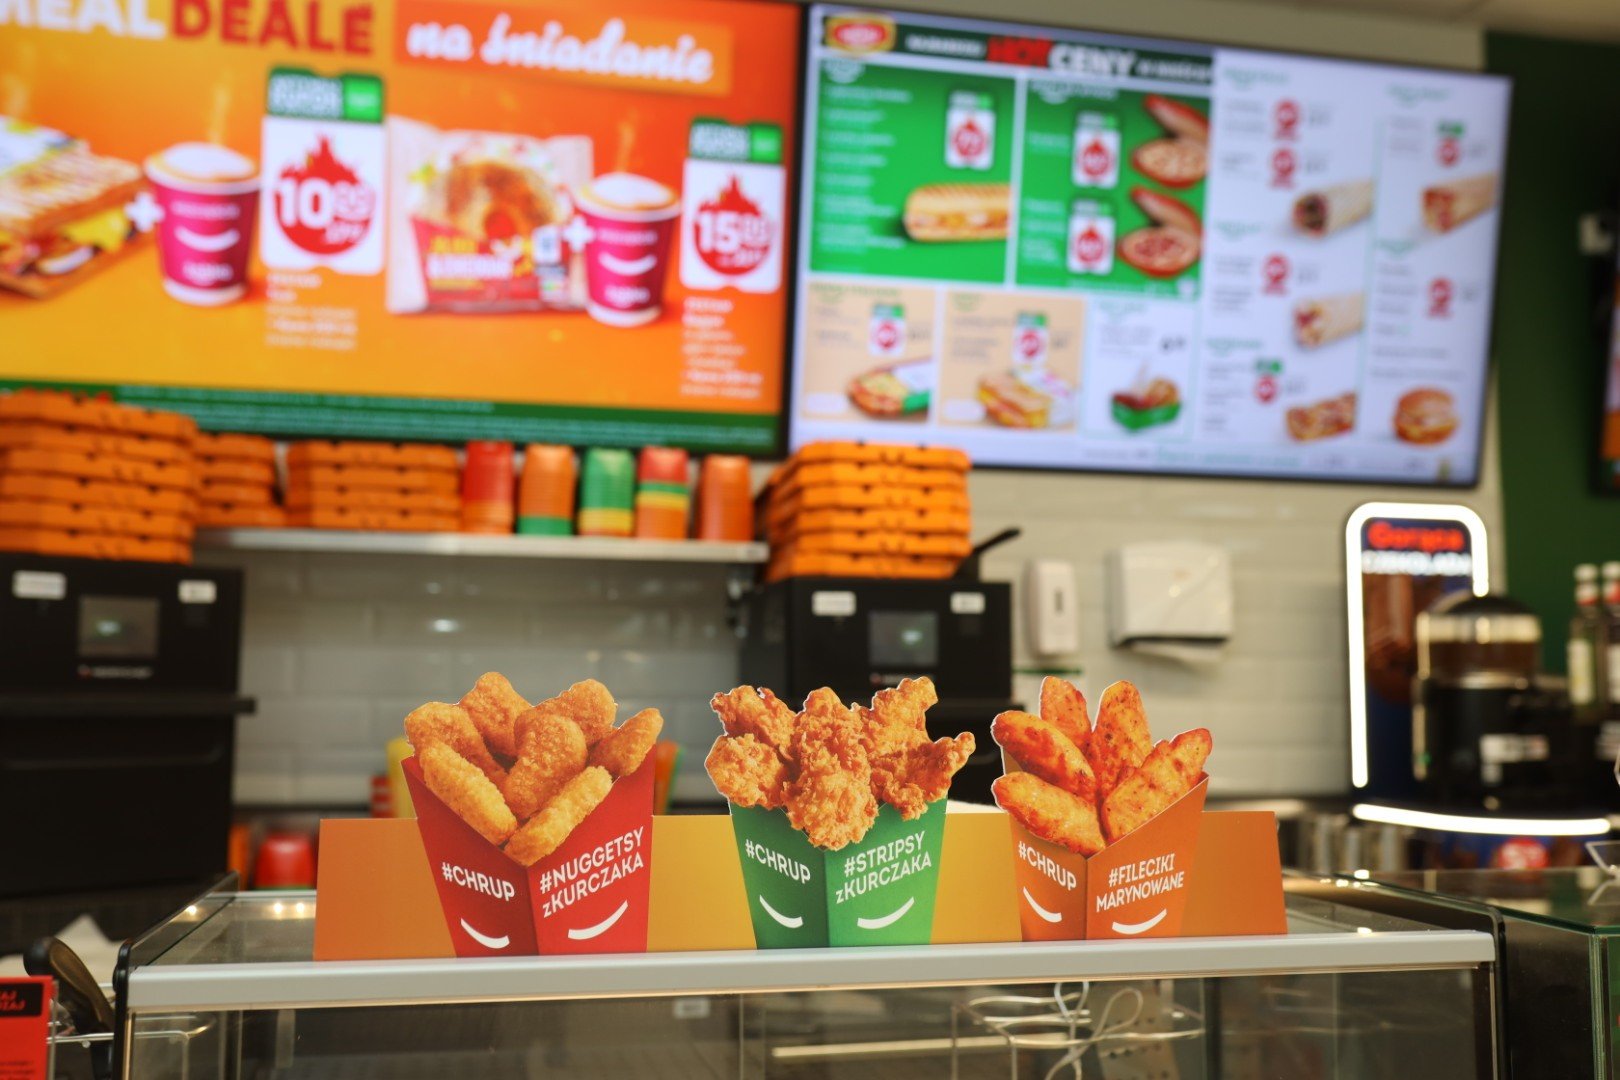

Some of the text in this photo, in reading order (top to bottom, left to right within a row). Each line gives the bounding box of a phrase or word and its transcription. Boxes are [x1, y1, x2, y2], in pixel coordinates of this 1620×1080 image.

[540, 826, 644, 894] #NUGGETSY
[745, 838, 811, 884] #CHRUP
[844, 831, 925, 878] #STRIPSY
[1018, 841, 1077, 891] #CHRUP
[1109, 853, 1175, 887] #FILECIKI
[441, 861, 515, 902] #CHRUP
[1096, 871, 1185, 913] MARYNOWANE
